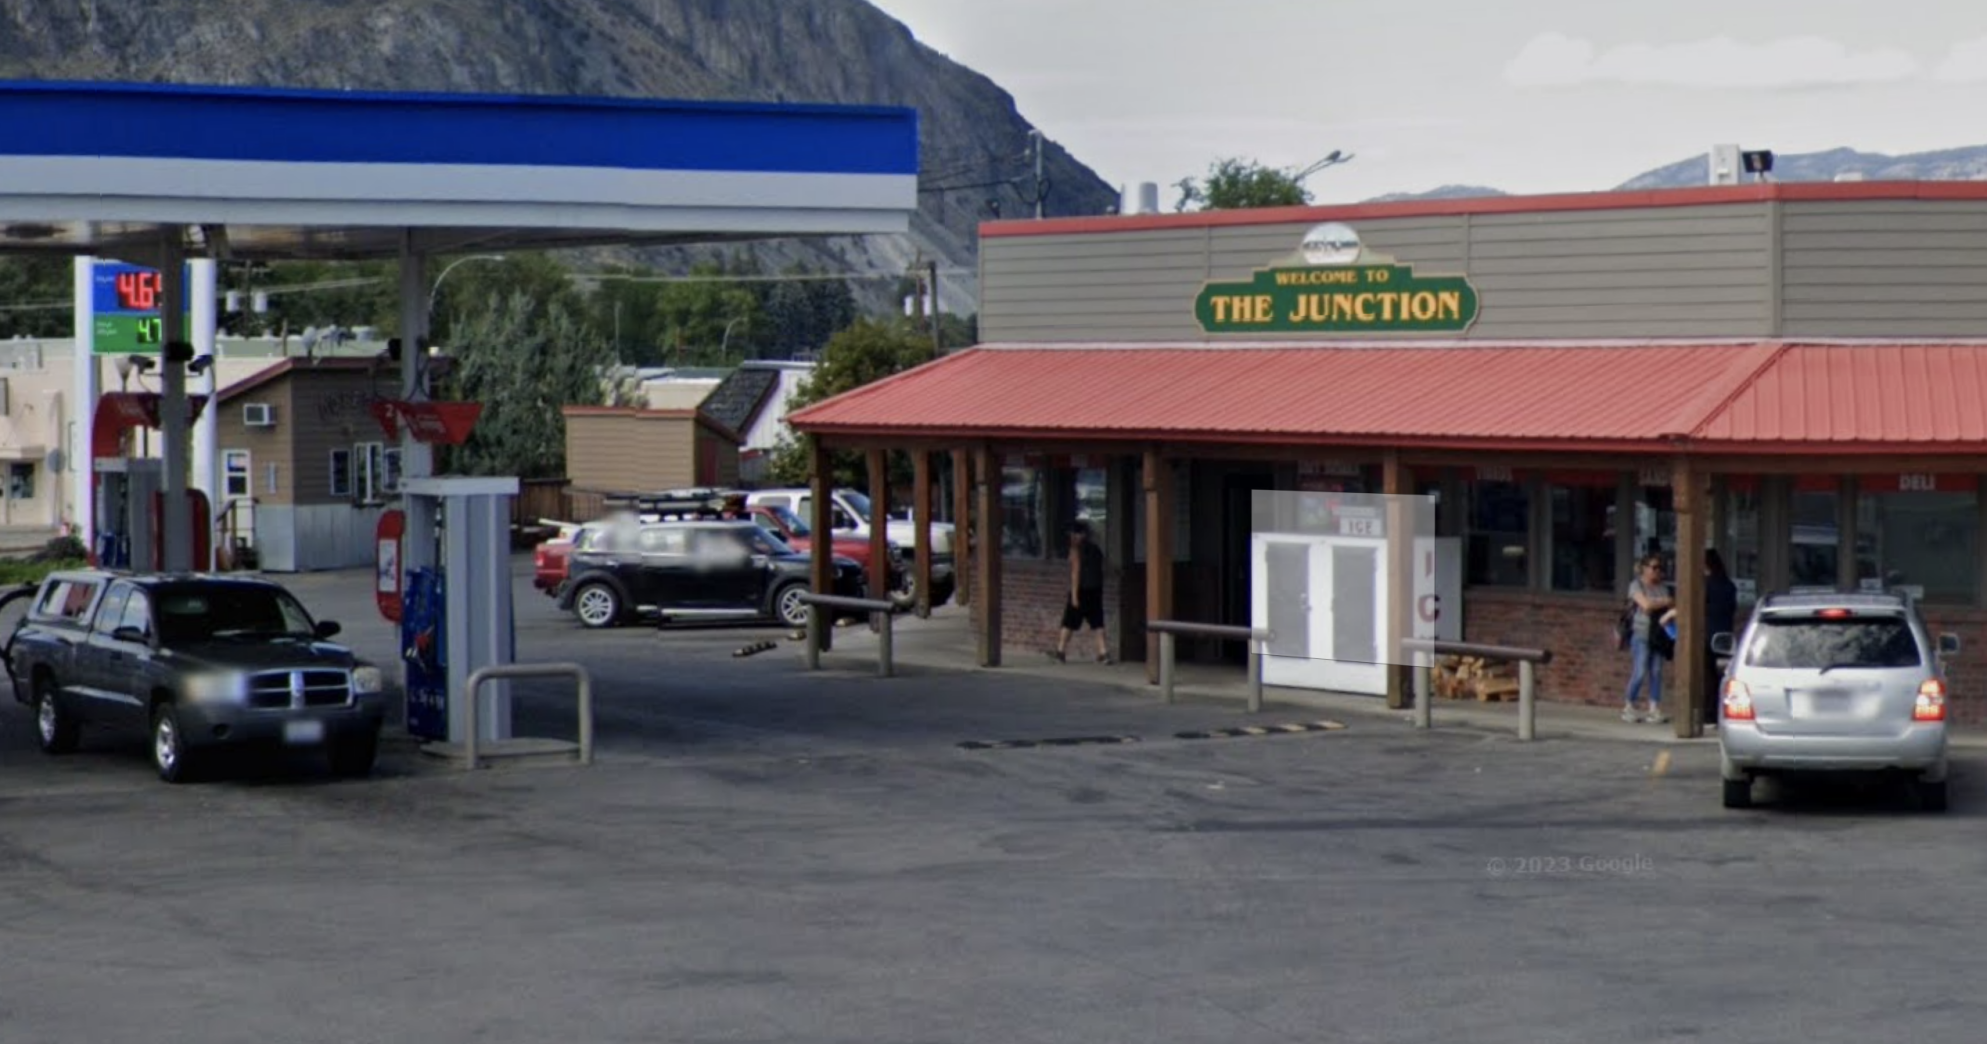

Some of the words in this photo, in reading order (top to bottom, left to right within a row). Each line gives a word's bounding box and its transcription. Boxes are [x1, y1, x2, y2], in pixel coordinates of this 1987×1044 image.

[1275, 271, 1358, 285] WELCOME
[1365, 269, 1389, 283] TO
[1210, 295, 1273, 322] THE
[1289, 291, 1460, 322] JUNCTION
[385, 403, 394, 417] 2
[1899, 474, 1935, 491] DELI
[1349, 519, 1373, 535] ICE
